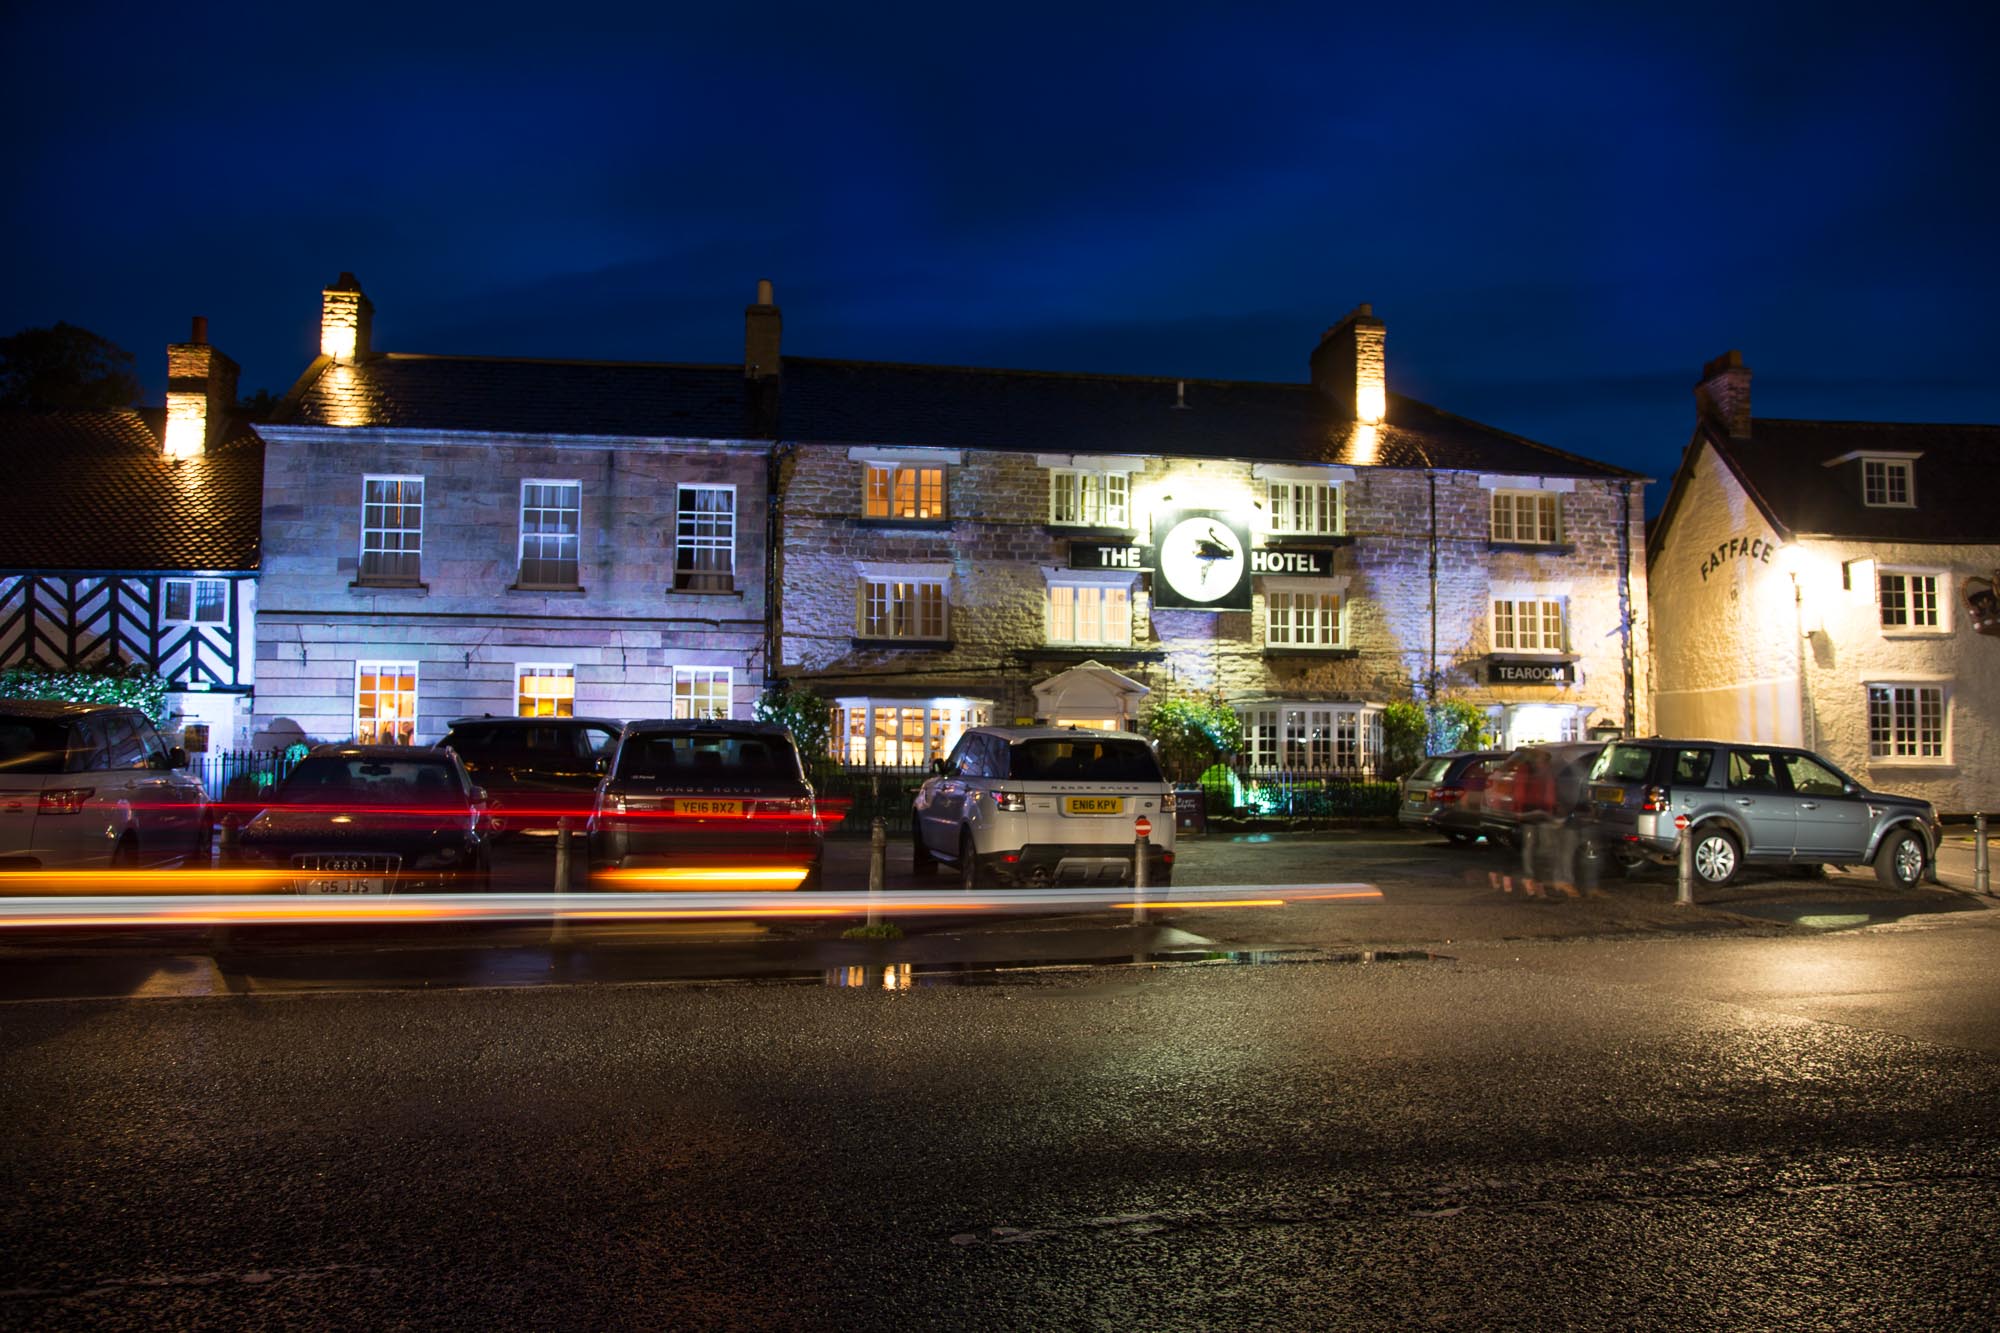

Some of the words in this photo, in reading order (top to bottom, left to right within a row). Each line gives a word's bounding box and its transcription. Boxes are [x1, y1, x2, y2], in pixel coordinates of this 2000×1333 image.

[1098, 547, 1141, 567] THE
[1251, 551, 1320, 572] HOTEL
[1701, 537, 1774, 581] FATFACE
[1499, 667, 1564, 680] TEAROOM
[683, 802, 709, 813] YE16
[712, 802, 735, 813] BXZ
[1072, 800, 1095, 810] EN16
